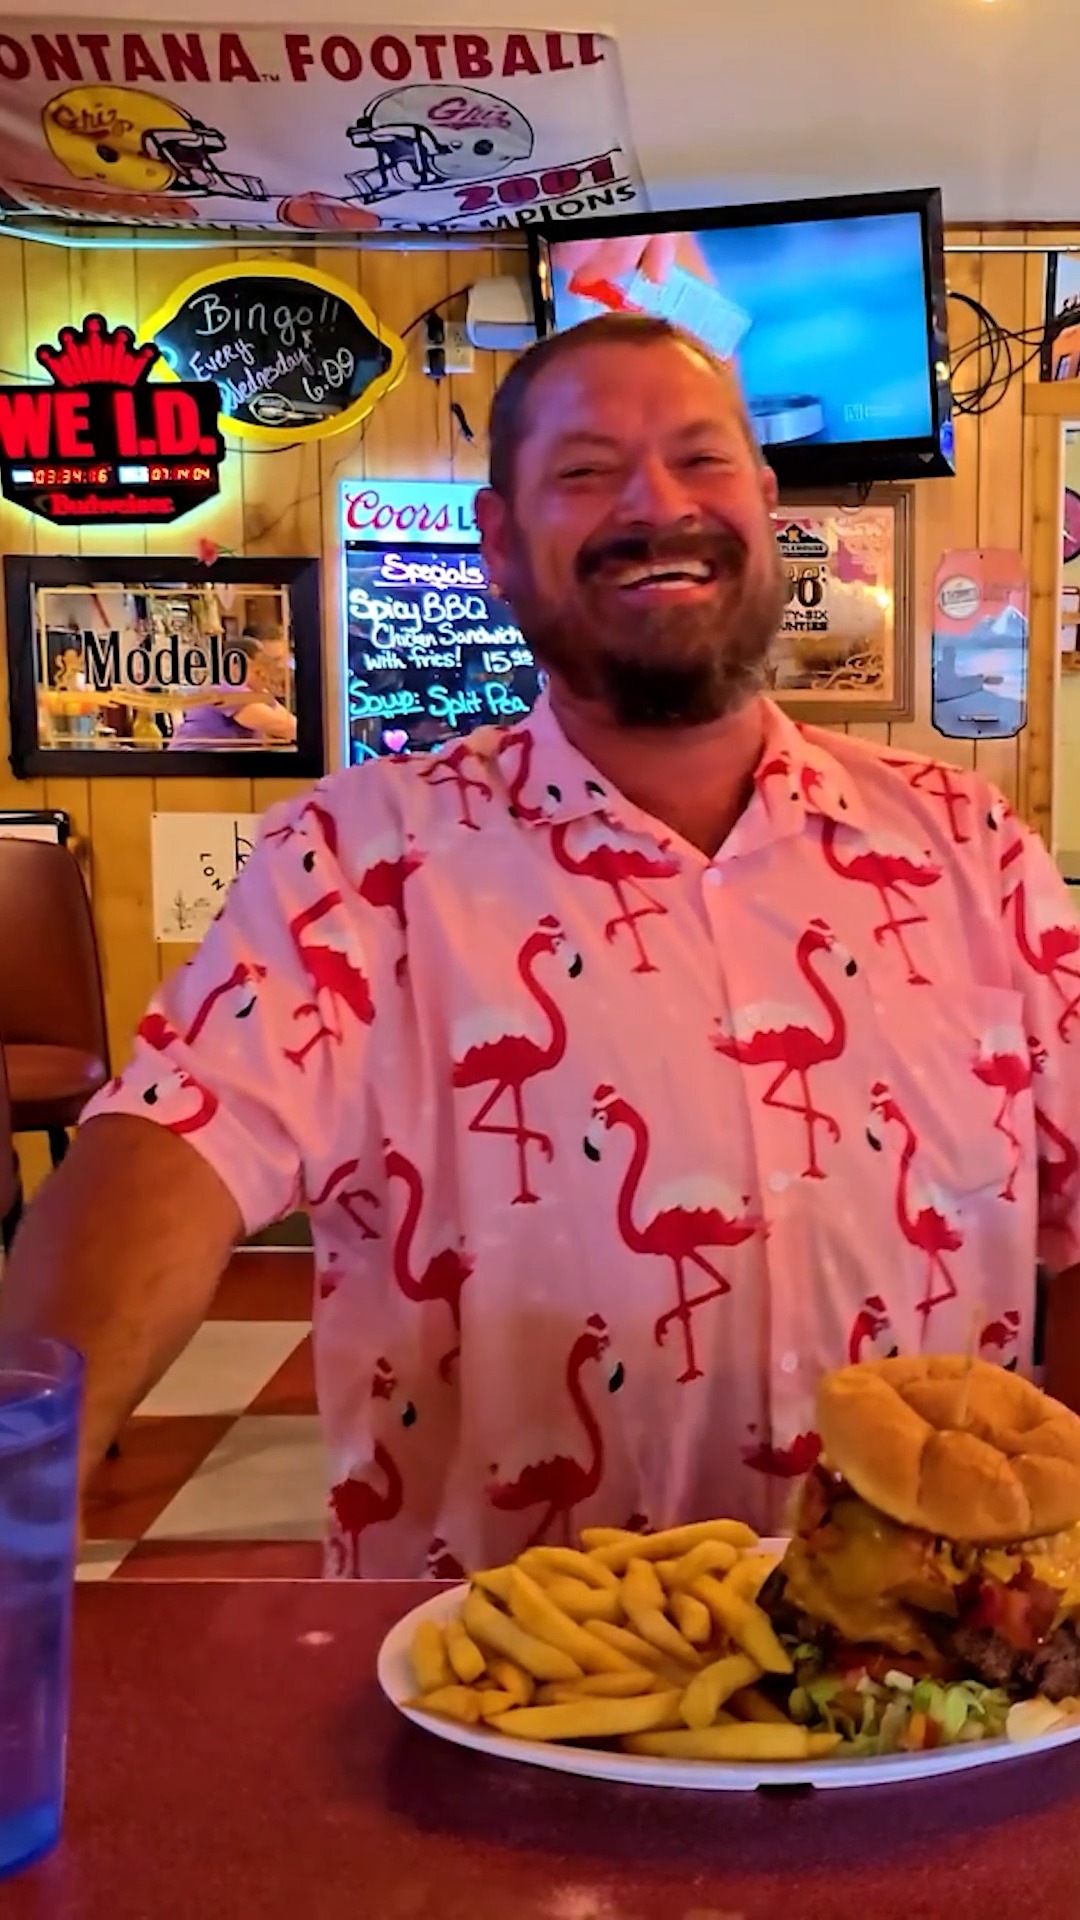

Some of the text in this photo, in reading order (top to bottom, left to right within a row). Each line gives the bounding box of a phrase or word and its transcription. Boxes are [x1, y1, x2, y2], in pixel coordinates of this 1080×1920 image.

[0, 34, 260, 82] ONTANA
[285, 33, 604, 82] FOOTBALL
[454, 158, 615, 211] 2001
[188, 293, 339, 347] Bingo!!
[0, 391, 95, 459] WE
[345, 490, 452, 531] Coors
[349, 589, 489, 632] Spicy BBQ
[372, 623, 527, 650] Chicken Sandwich
[408, 646, 463, 671] fries!
[83, 630, 248, 691] Modelo
[427, 685, 483, 727] Split
[485, 682, 531, 716] Pea
